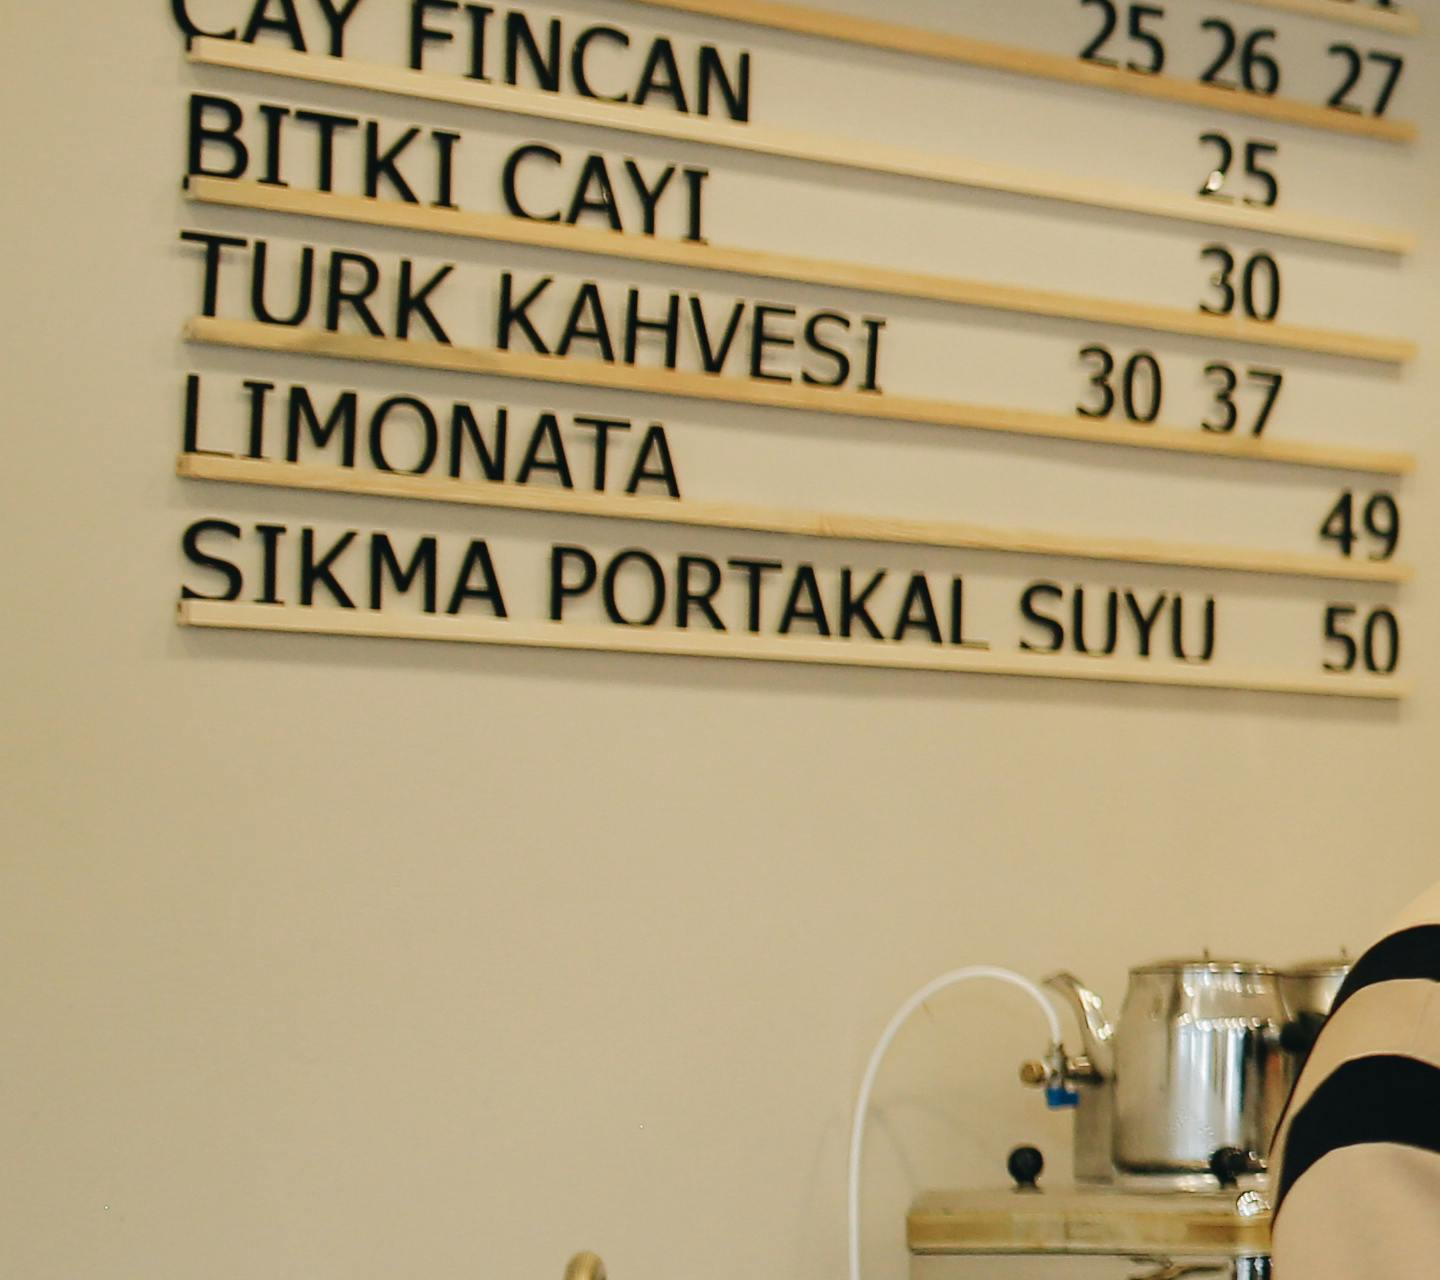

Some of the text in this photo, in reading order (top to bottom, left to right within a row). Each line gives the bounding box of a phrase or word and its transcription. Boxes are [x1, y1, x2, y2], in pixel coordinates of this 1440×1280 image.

[1199, 18, 1280, 98] 26
[1326, 42, 1404, 119] 27
[186, 93, 1281, 323] BITKI CAYI 30
[1197, 132, 1279, 208] 25
[180, 229, 1283, 439] TURK KAHVESI 30 37
[182, 374, 1401, 561] LIMONATA 49
[180, 518, 1400, 675] SIKMA PORTAKAL SUYU 50
